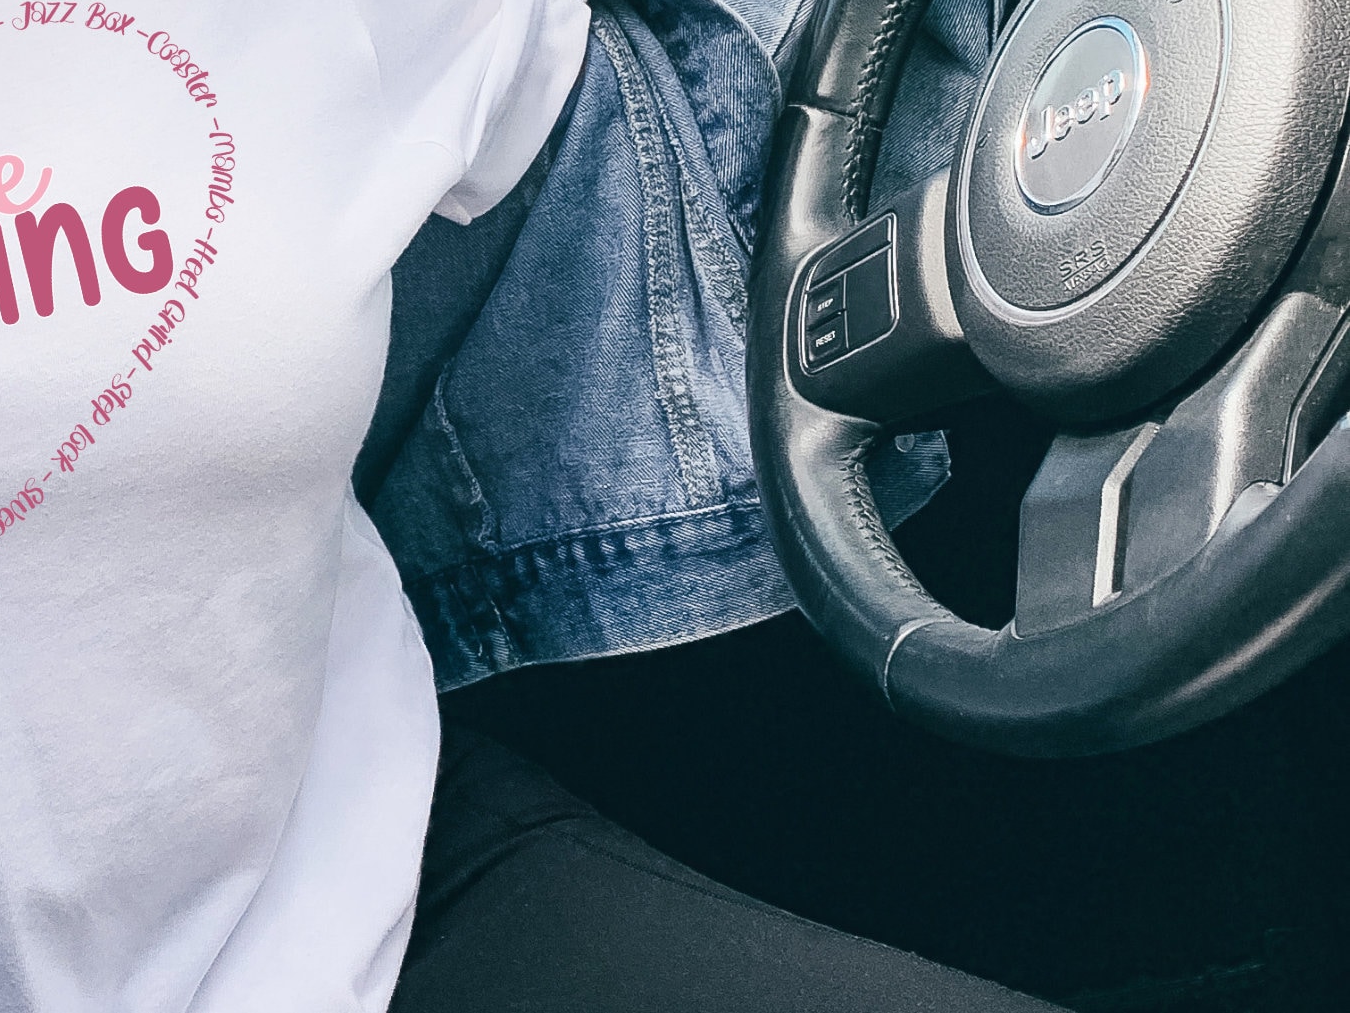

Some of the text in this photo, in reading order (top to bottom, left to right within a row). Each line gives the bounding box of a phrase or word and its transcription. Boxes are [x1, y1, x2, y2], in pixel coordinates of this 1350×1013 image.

[1027, 69, 1125, 160] Jeep
[84, 2, 136, 36] Box
[131, 299, 186, 372] Grind
[1058, 239, 1105, 278] SRS
